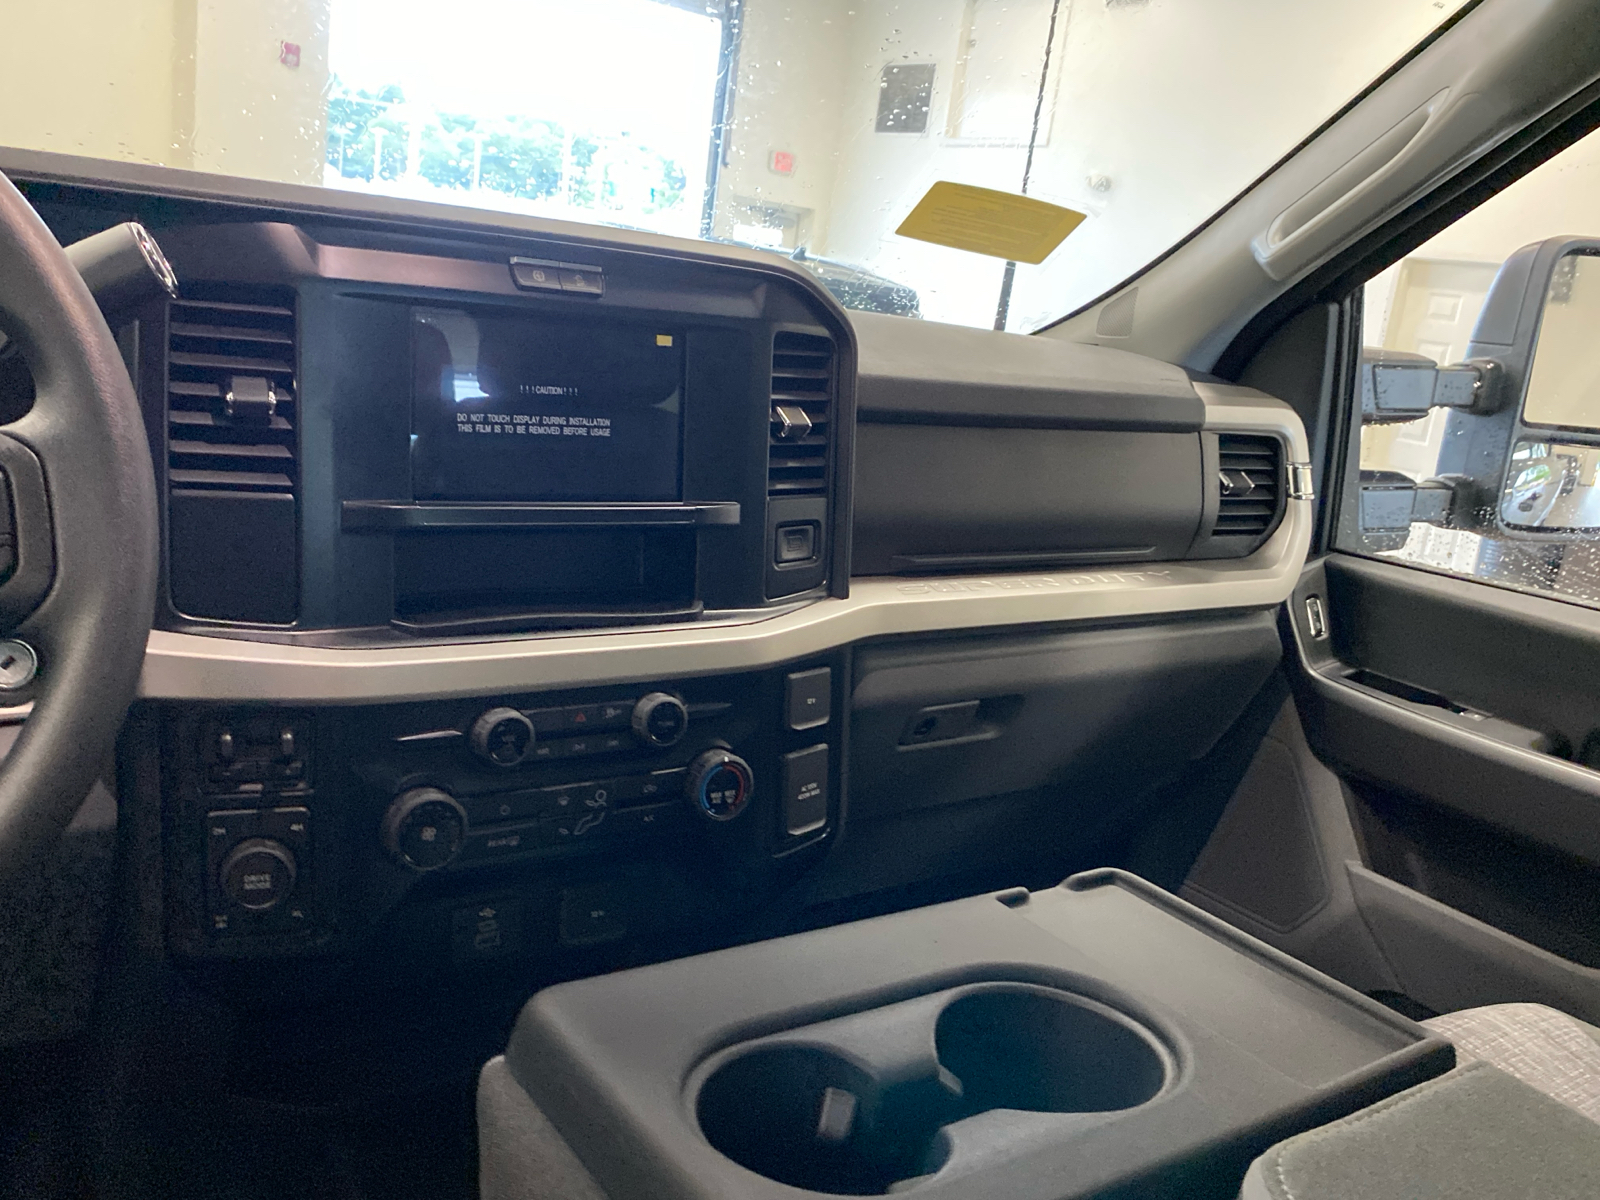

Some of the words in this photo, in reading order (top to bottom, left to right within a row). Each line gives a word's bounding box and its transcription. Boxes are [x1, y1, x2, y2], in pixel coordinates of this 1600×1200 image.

[456, 413, 468, 422] DO
[470, 413, 484, 422] NOT
[487, 414, 510, 423] TOUCH
[513, 415, 540, 424] DISPLAY
[542, 416, 567, 425] DURING
[569, 417, 611, 427] INSTALLATION
[457, 424, 473, 433] THIS
[475, 424, 492, 433] FILM
[494, 425, 502, 433] IS
[504, 425, 514, 433] TO
[516, 425, 527, 434] BE
[529, 426, 561, 435] REMOVED
[563, 427, 588, 436] BEFORE
[590, 428, 611, 437] USAGE
[896, 575, 1060, 596] SUPER
[1061, 570, 1172, 587] DUTY
